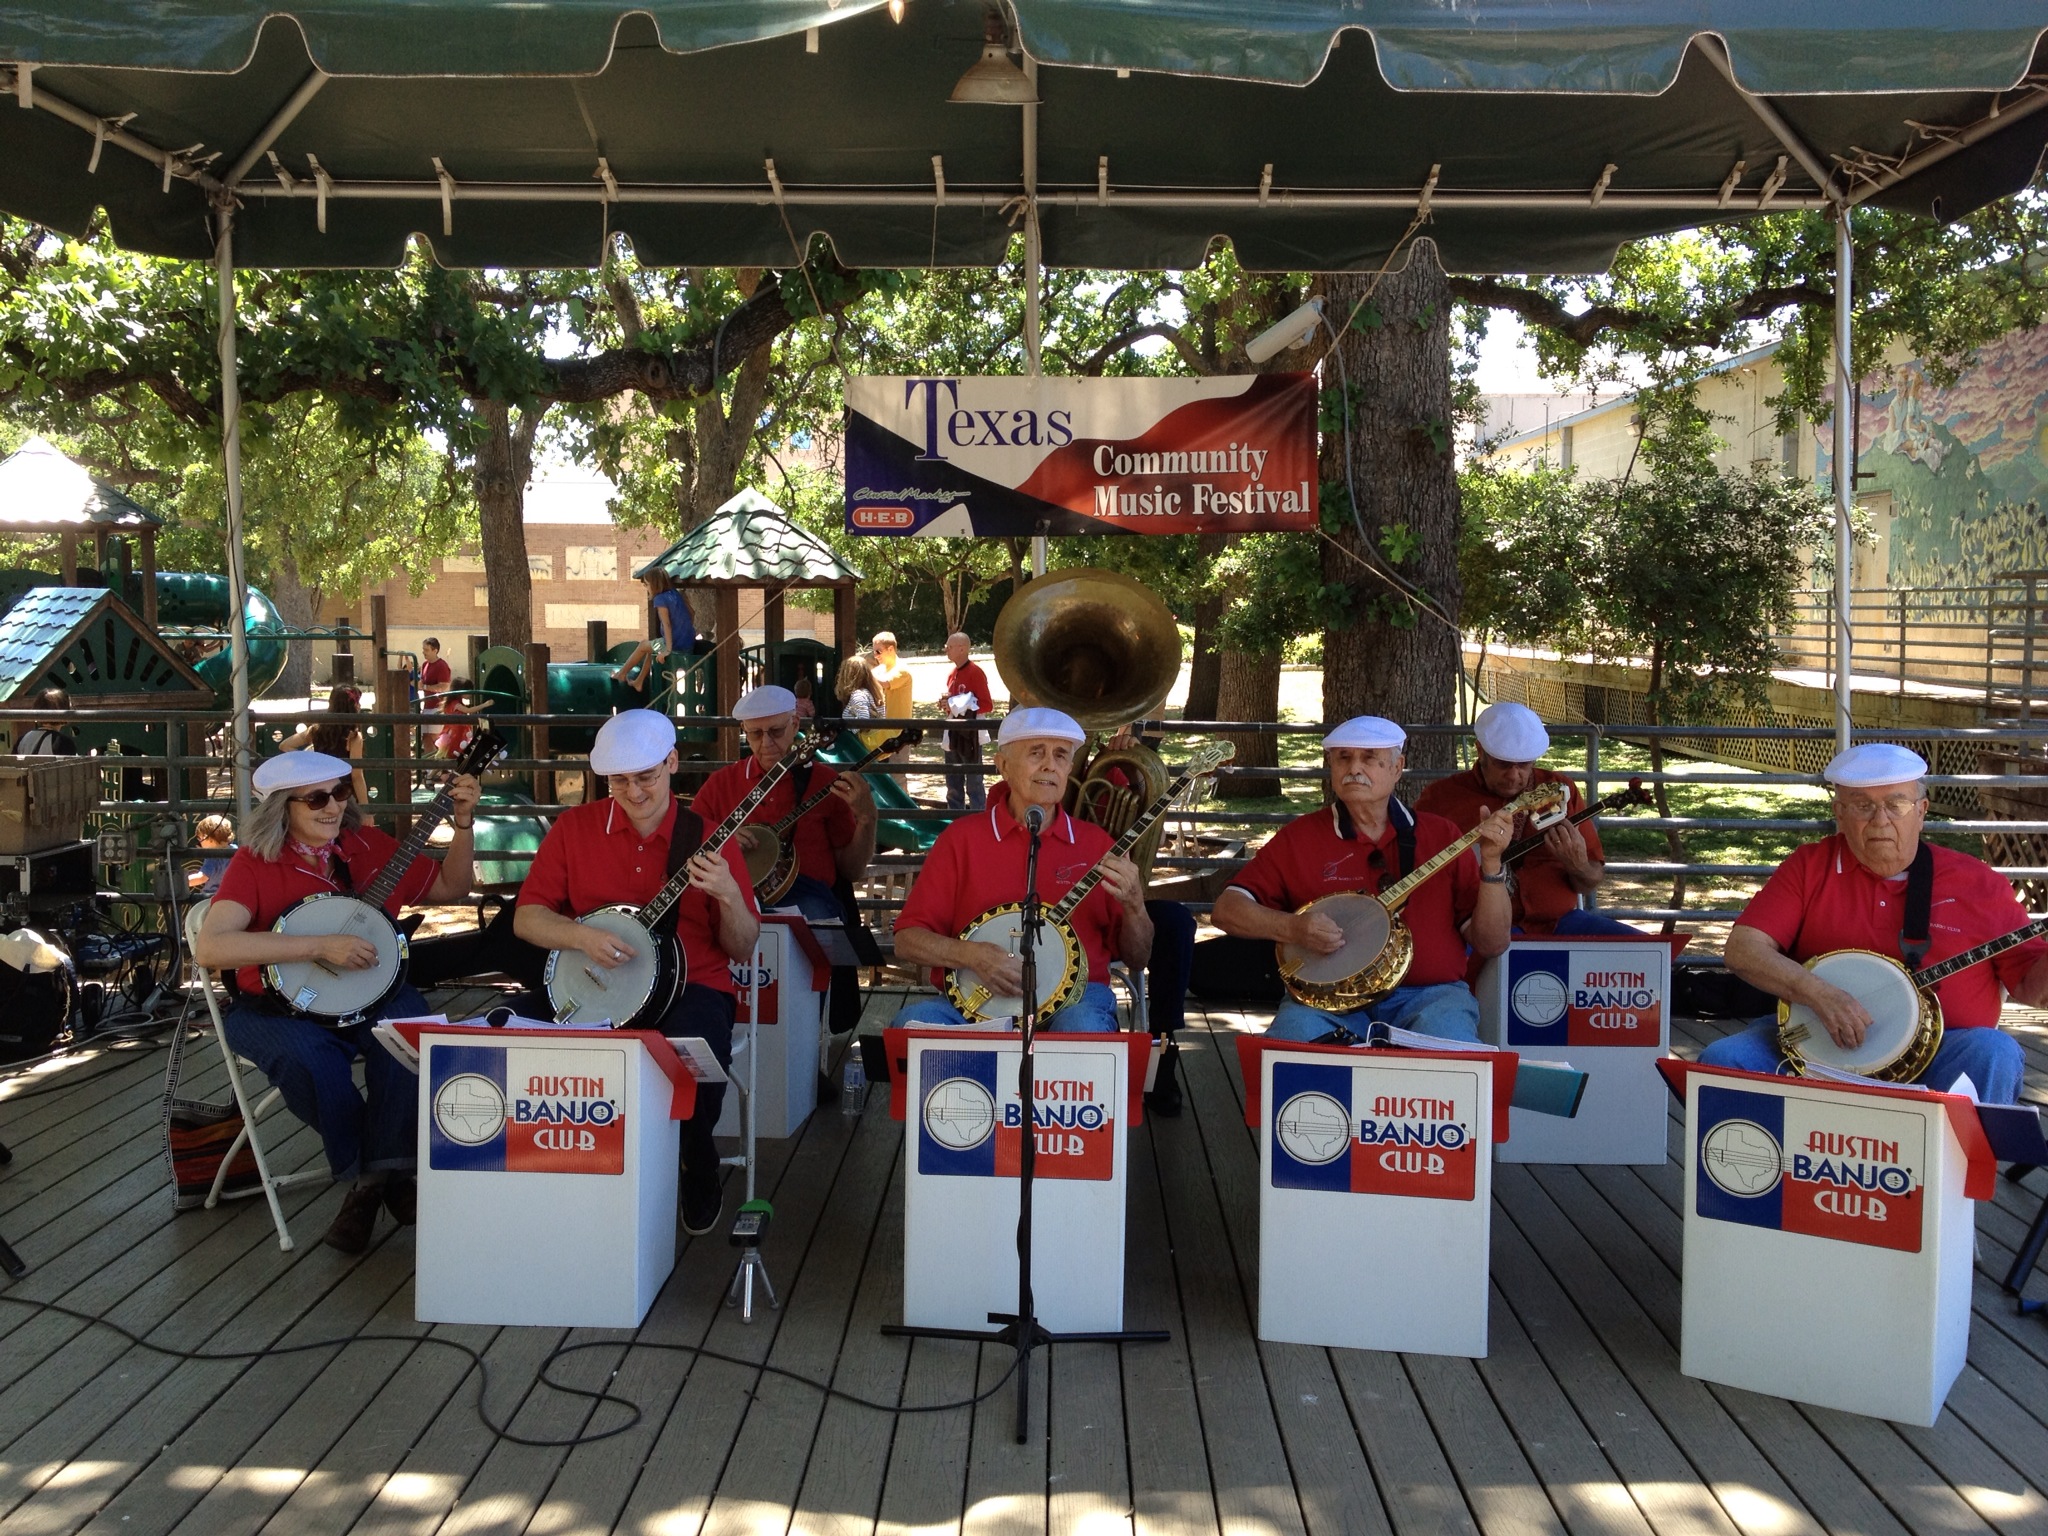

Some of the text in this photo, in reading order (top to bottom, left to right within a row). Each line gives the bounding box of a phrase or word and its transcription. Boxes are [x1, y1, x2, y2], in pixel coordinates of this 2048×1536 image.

[905, 379, 1073, 460] Texas
[1093, 442, 1269, 481] Community
[1093, 481, 1312, 516] Music Festival
[1582, 972, 1645, 988] AUSTIN
[1575, 990, 1653, 1009] BANJO
[1589, 1013, 1638, 1029] CLUB
[524, 1075, 604, 1098] AUSTIN
[1014, 1080, 1094, 1101] USTIN
[515, 1099, 615, 1125] BANJO
[1369, 1096, 1455, 1121] AUSTIN
[533, 1129, 596, 1151] CLUB
[1033, 1134, 1085, 1155] LUB
[1361, 1119, 1465, 1148] BANJO
[1803, 1130, 1899, 1165] AUSTIN
[1379, 1150, 1445, 1175] CLUB
[1793, 1153, 1910, 1194] BANJO
[1813, 1190, 1887, 1222] CLUB
